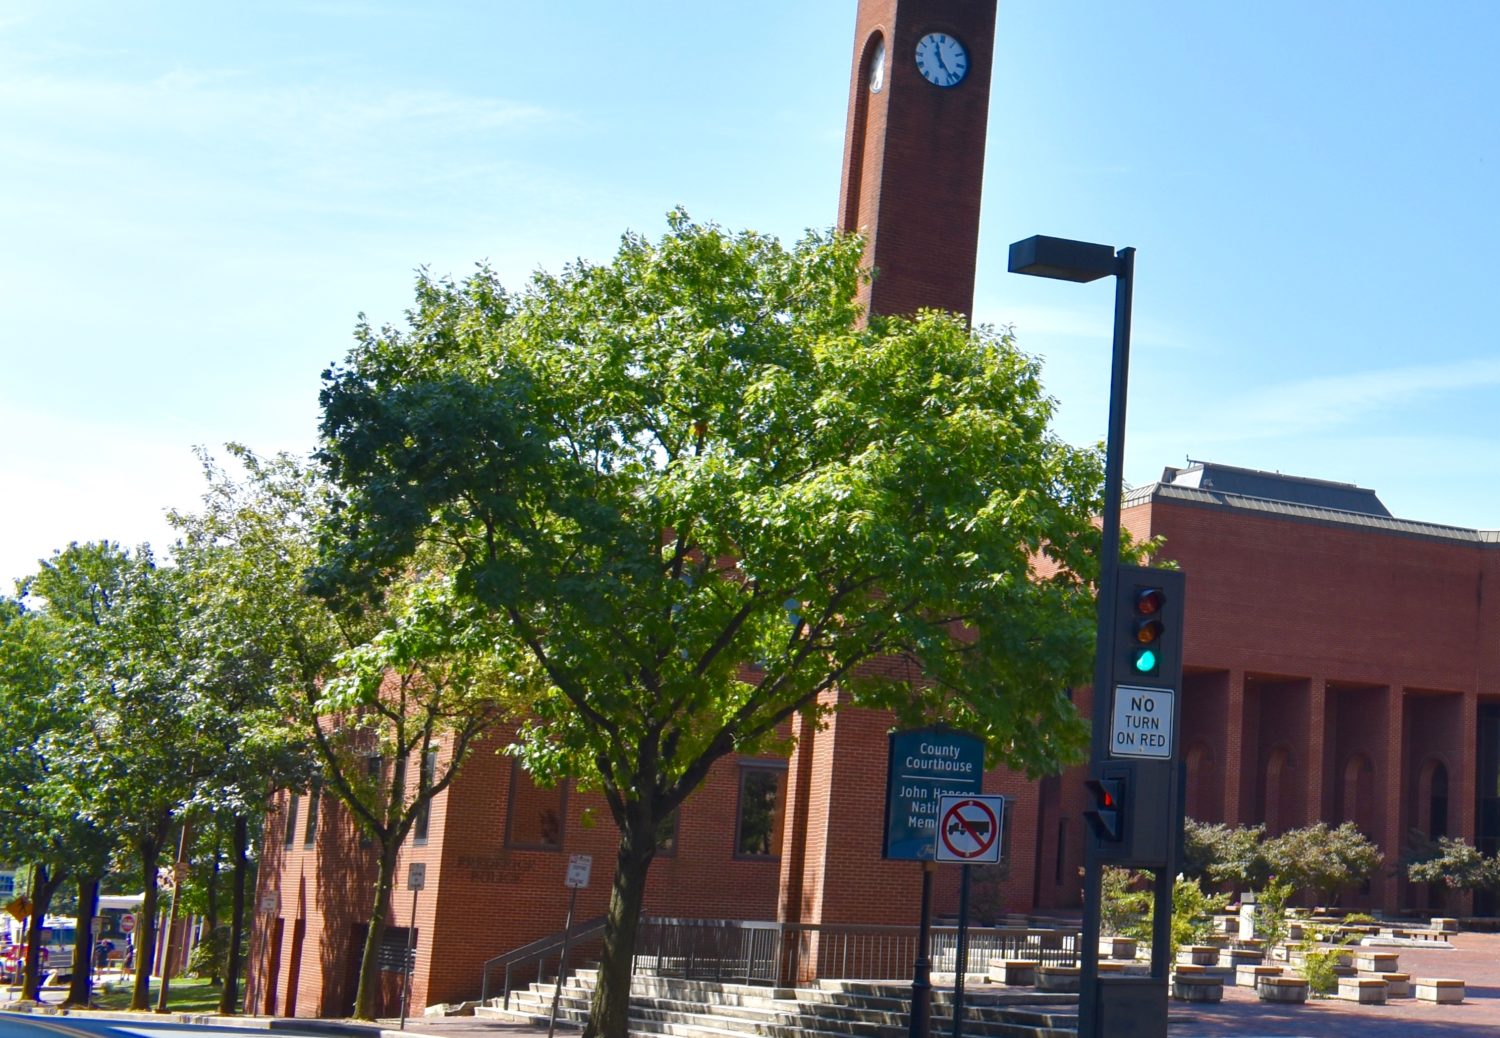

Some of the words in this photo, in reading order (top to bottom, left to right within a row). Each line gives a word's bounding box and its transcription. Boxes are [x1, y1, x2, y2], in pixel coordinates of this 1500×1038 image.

[1131, 697, 1155, 713] NO
[1125, 715, 1160, 730] TURN
[1117, 731, 1135, 745] ON
[1140, 733, 1166, 747] RED
[920, 742, 961, 759] County
[905, 756, 973, 772] Courthouse
[899, 785, 928, 798] John
[908, 815, 938, 828] Mem
